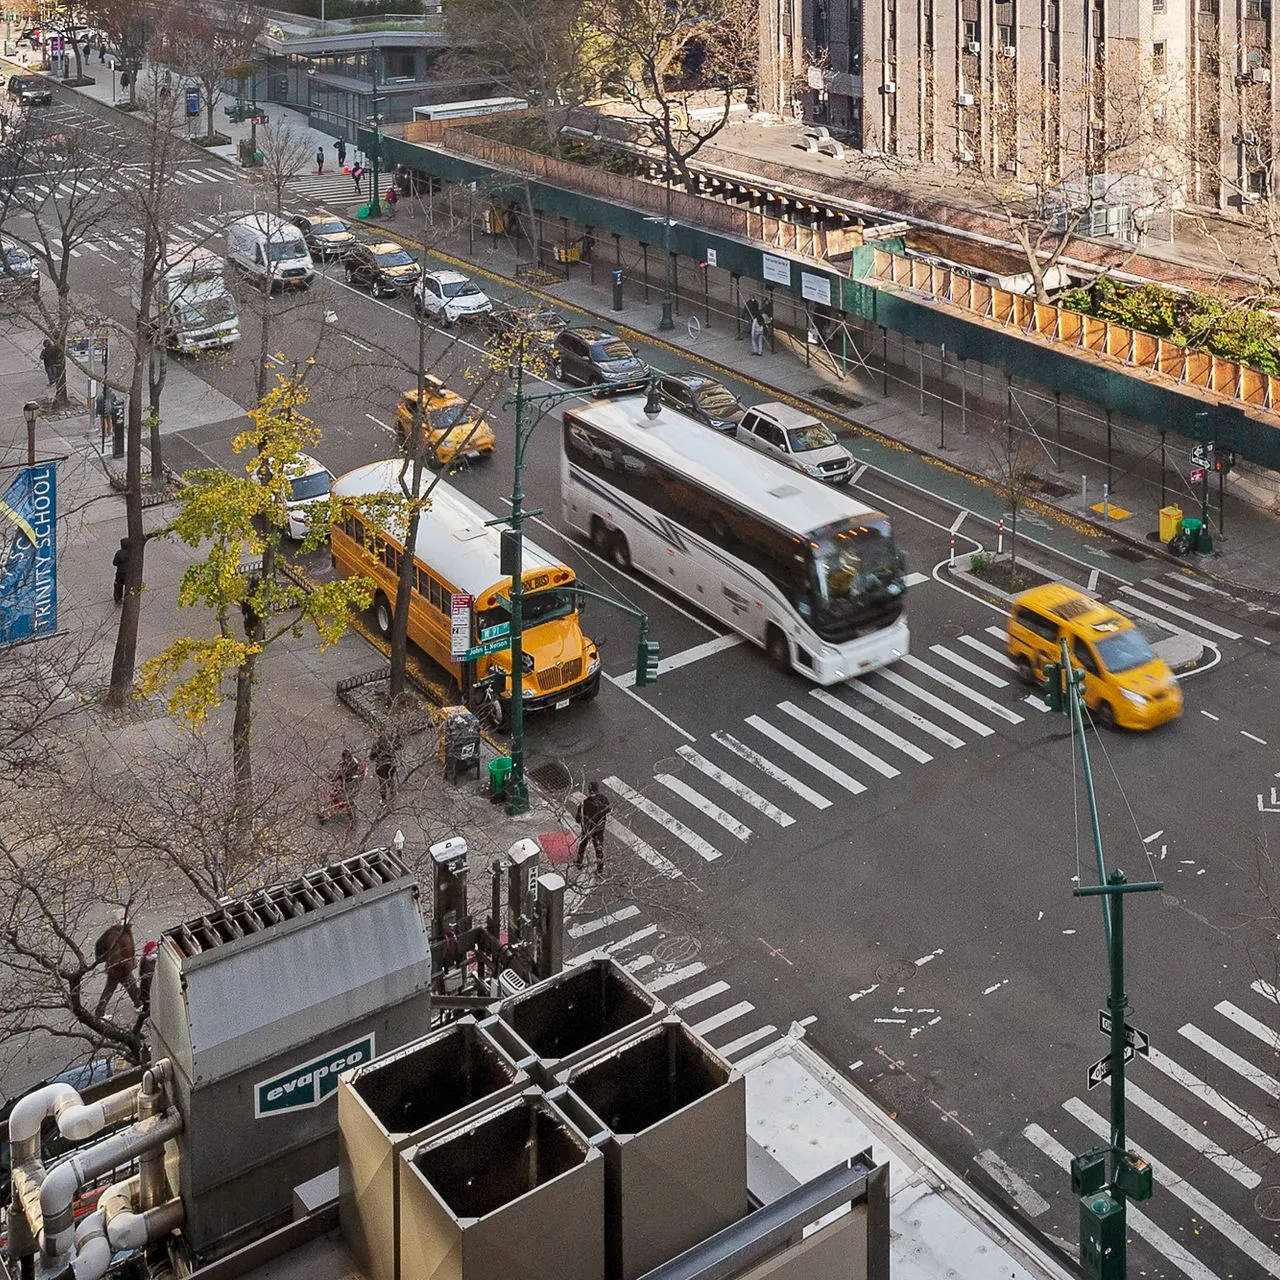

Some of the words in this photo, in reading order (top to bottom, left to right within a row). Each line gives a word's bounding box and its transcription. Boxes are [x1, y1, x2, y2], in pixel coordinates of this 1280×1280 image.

[34, 469, 51, 549] SCHOOL
[34, 557, 51, 631] TRINITY
[469, 647, 484, 656] John
[492, 627, 500, 636] 91
[267, 1051, 363, 1103] evapco
